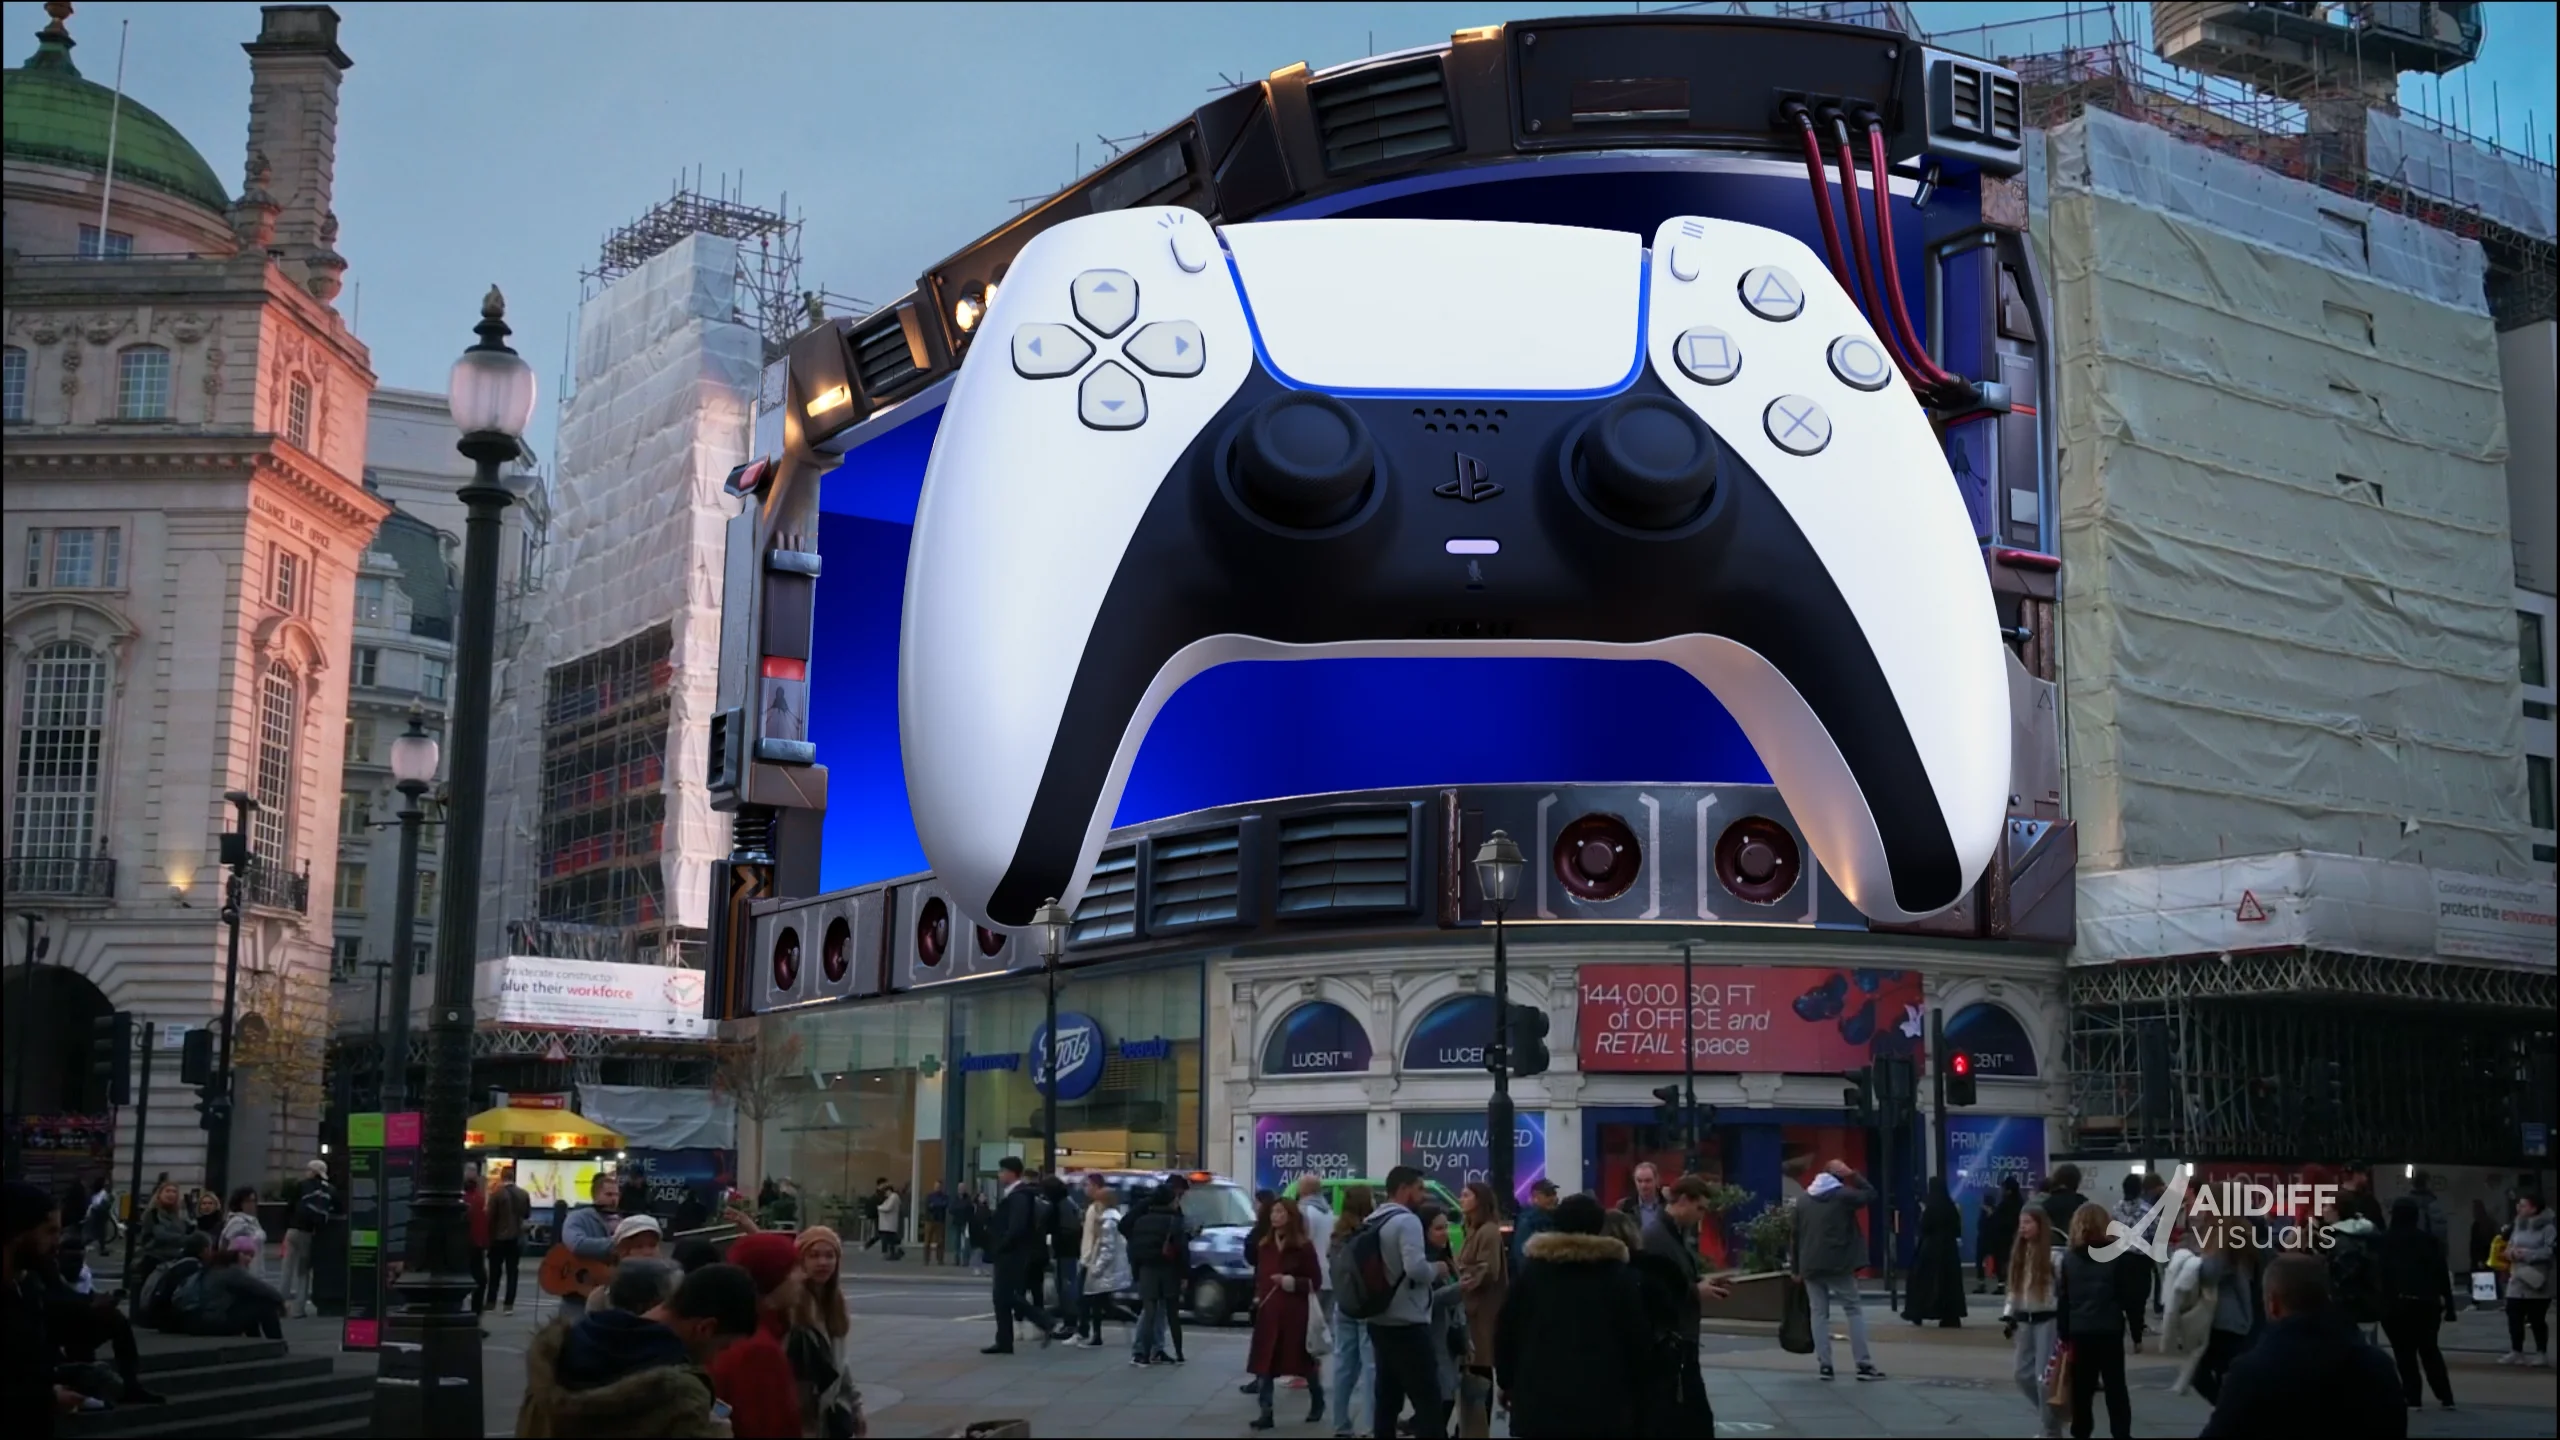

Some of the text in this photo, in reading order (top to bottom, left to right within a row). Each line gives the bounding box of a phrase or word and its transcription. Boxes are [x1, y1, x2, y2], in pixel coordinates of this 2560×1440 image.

[253, 495, 285, 525] ALLIANCE
[308, 527, 332, 551] OFFICE
[2440, 902, 2481, 918] protect
[2482, 902, 2500, 920] the
[533, 982, 563, 994] their
[567, 984, 634, 1000] workforce
[1580, 983, 1756, 1008] 144,000 SQ FT
[1608, 1007, 1770, 1031] of OFFICE and
[1118, 1034, 1169, 1061] beauty
[1439, 1048, 1485, 1063] LUCE
[1595, 1032, 1750, 1060] RETAIL space
[1292, 1051, 1341, 1068] LUCENT
[1264, 1131, 1309, 1150] PRIME
[1412, 1129, 1534, 1149] ILLUMINED
[1951, 1131, 1994, 1150] PRIME
[1272, 1151, 1349, 1171] retail space
[1422, 1151, 1469, 1171] by an
[1991, 1155, 2030, 1171] space
